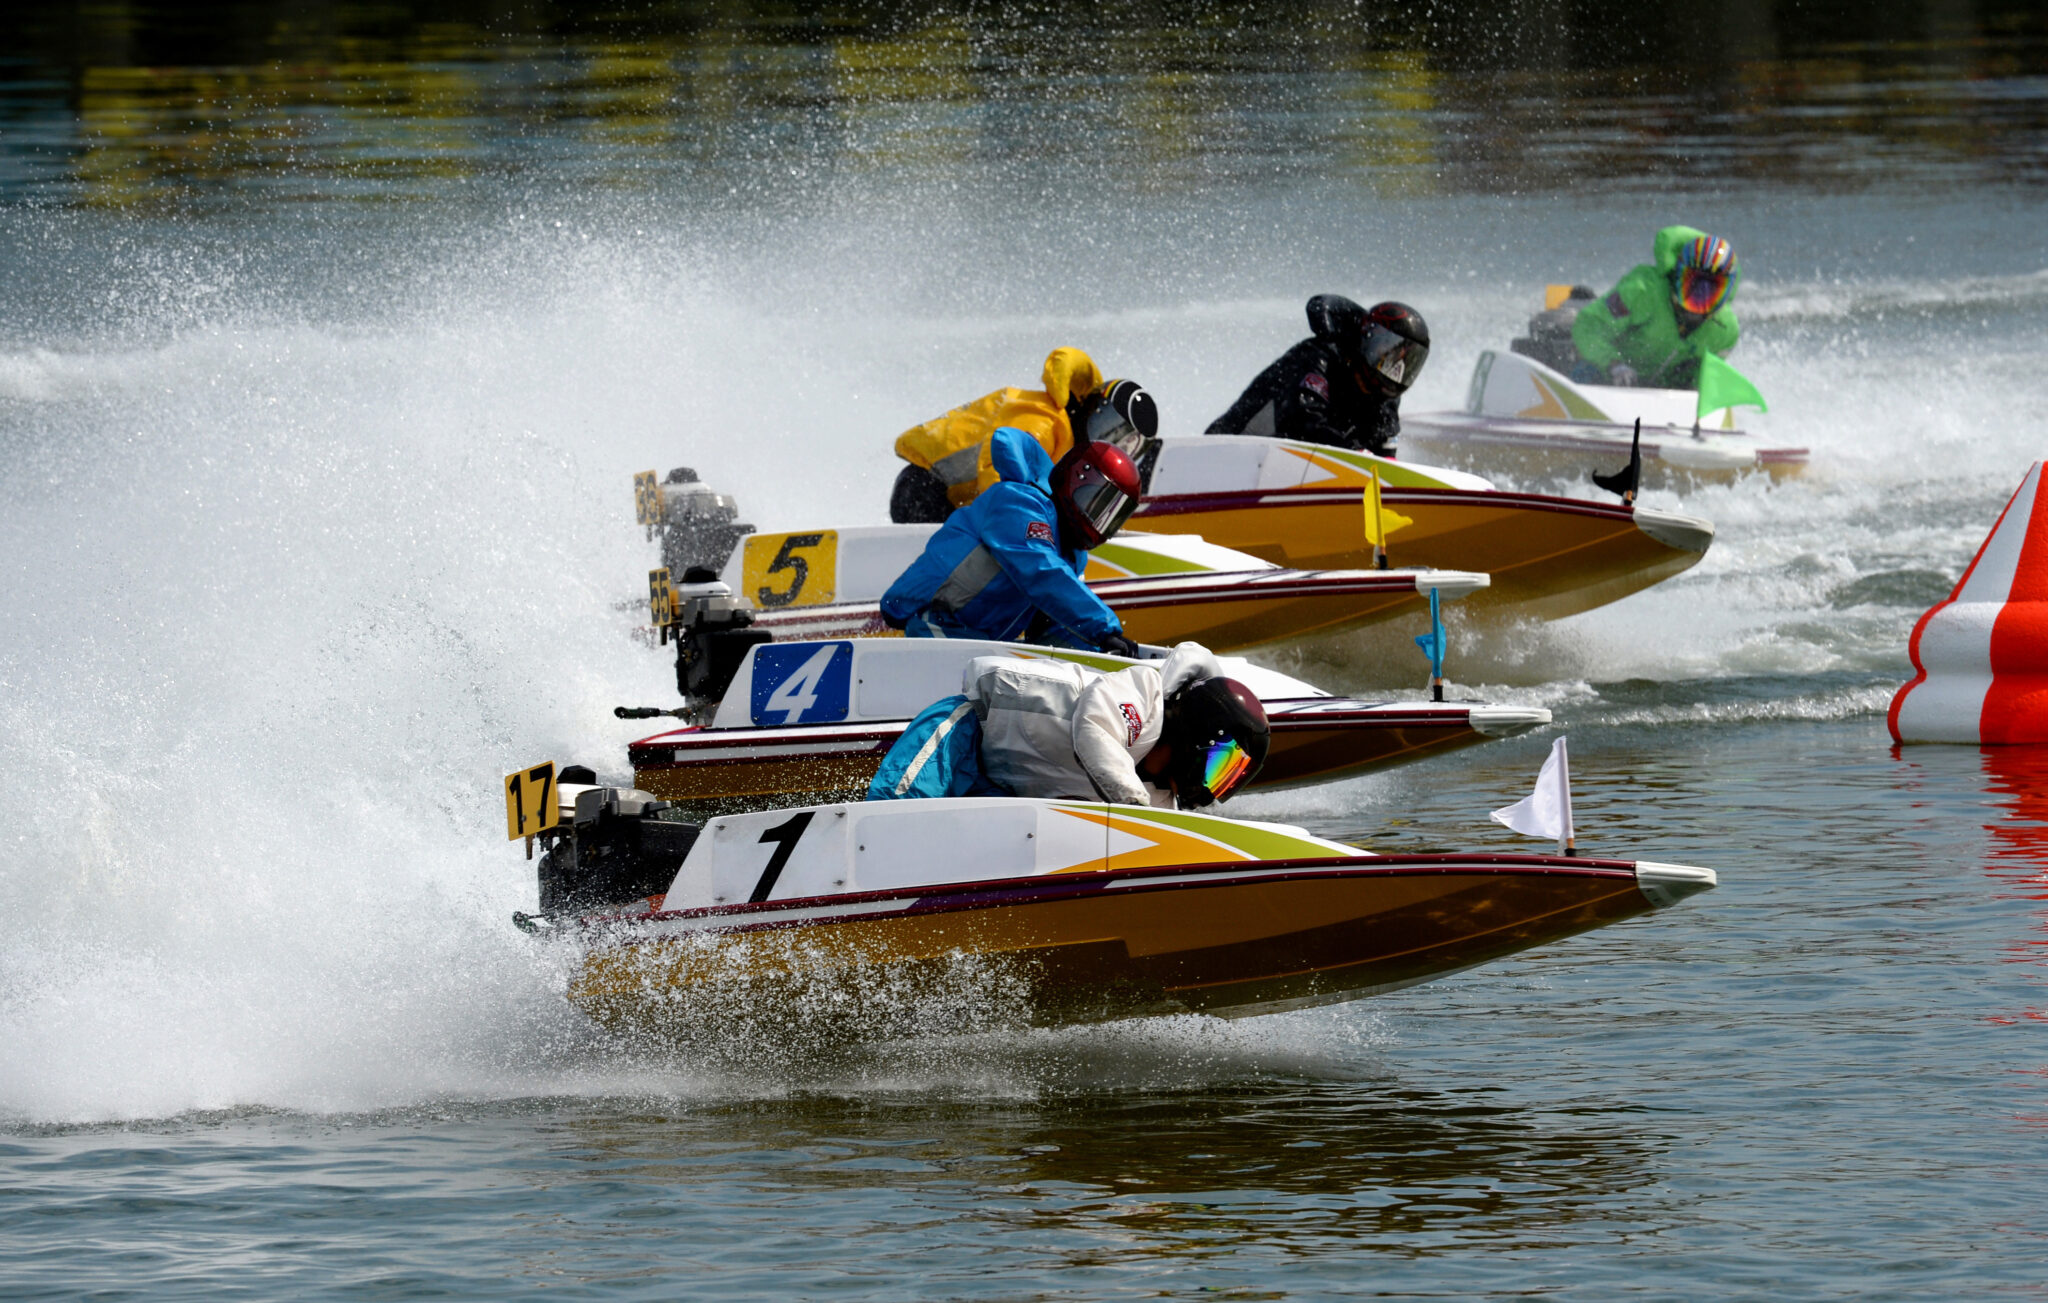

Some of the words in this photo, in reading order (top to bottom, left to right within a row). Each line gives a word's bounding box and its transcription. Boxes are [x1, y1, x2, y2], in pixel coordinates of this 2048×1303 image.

[649, 571, 670, 624] 55
[758, 534, 824, 606] 5
[764, 644, 839, 723] 4
[508, 763, 553, 834] 17
[748, 811, 816, 903] 1
